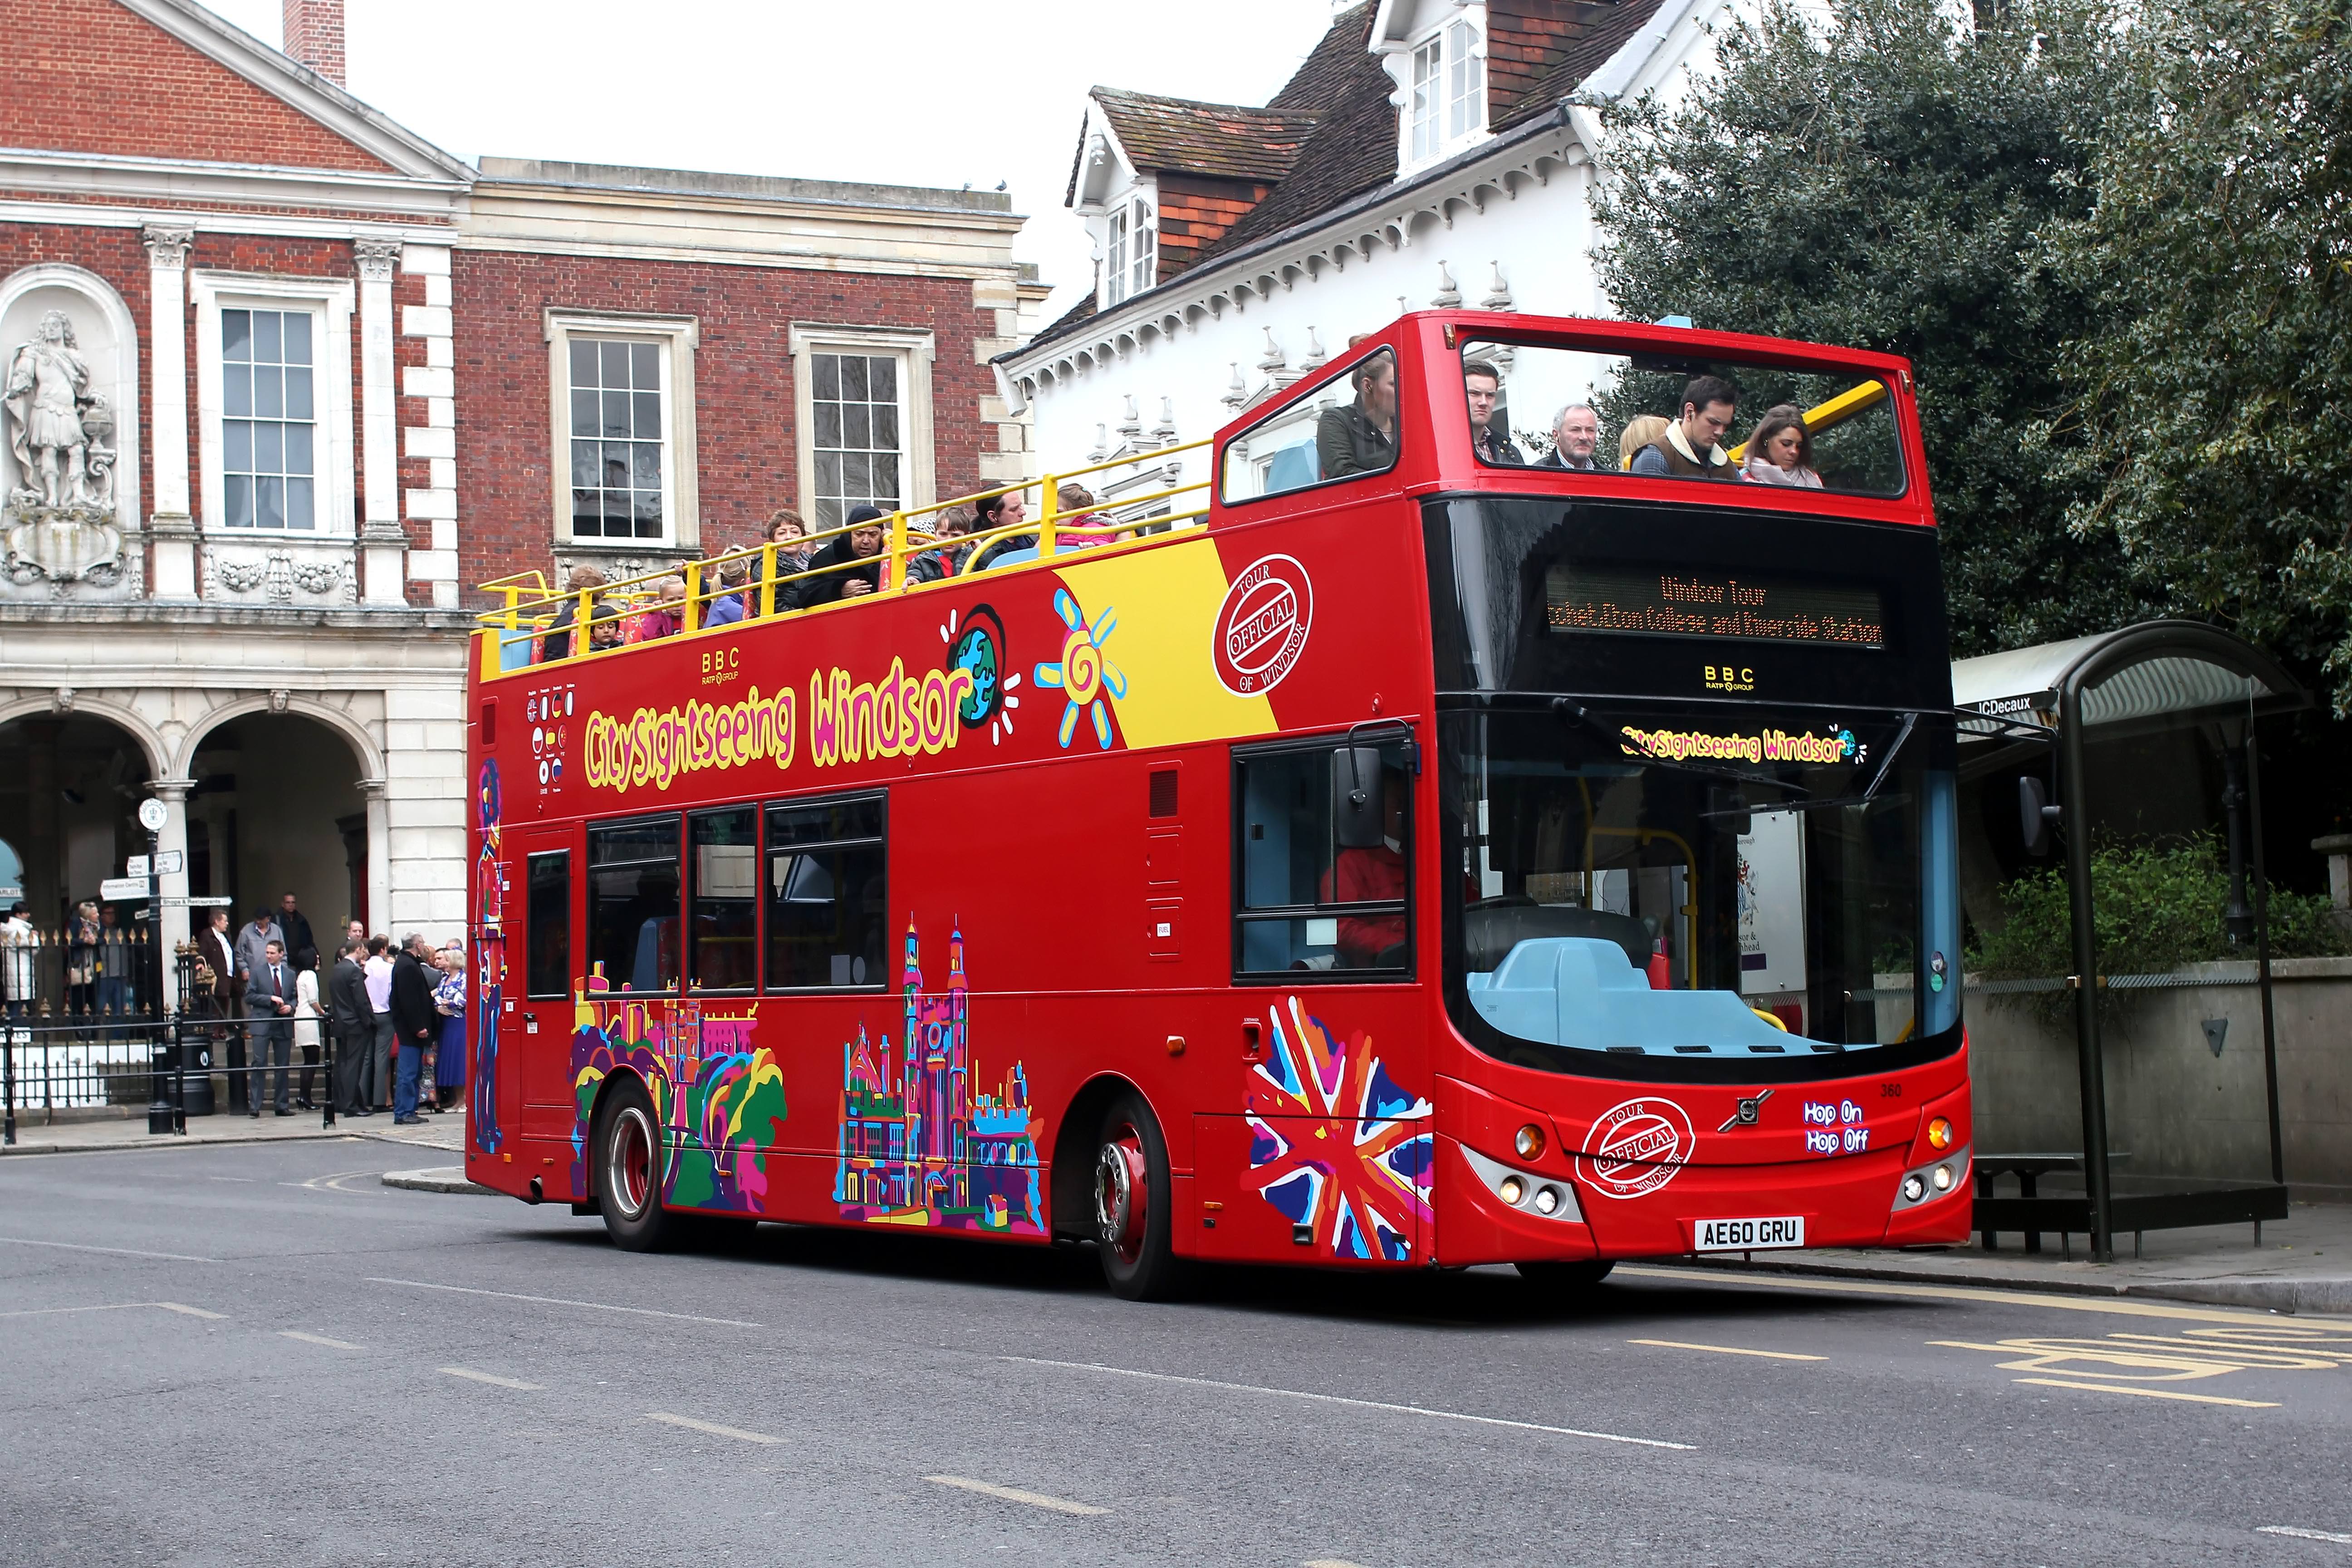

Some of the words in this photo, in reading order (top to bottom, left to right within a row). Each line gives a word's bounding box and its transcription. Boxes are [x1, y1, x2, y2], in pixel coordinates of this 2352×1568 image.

[1238, 564, 1270, 597] TOUR
[1661, 576, 1724, 603] Windsor
[1729, 580, 1766, 606] Tour
[1230, 598, 1294, 656] OFFICIAL
[1240, 676, 1253, 691] OF
[1260, 622, 1305, 686] WINDSOR
[702, 675, 715, 686] RATP
[722, 671, 739, 681] GROUP
[810, 656, 975, 767] Windsor
[1763, 728, 1846, 763] Windsor
[1750, 931, 1756, 941] &
[1881, 1083, 1902, 1097] 360
[1607, 1103, 1645, 1126] TOUR
[1804, 1102, 1836, 1127] Hop
[1841, 1099, 1862, 1123] On
[1598, 1128, 1676, 1171] OFFICIAL
[1807, 1130, 1839, 1155] Hop
[1843, 1128, 1869, 1151] Off
[1632, 1153, 1684, 1191] WINDSOR
[1704, 1222, 1753, 1245] AE60
[1759, 1220, 1796, 1242] GRU
